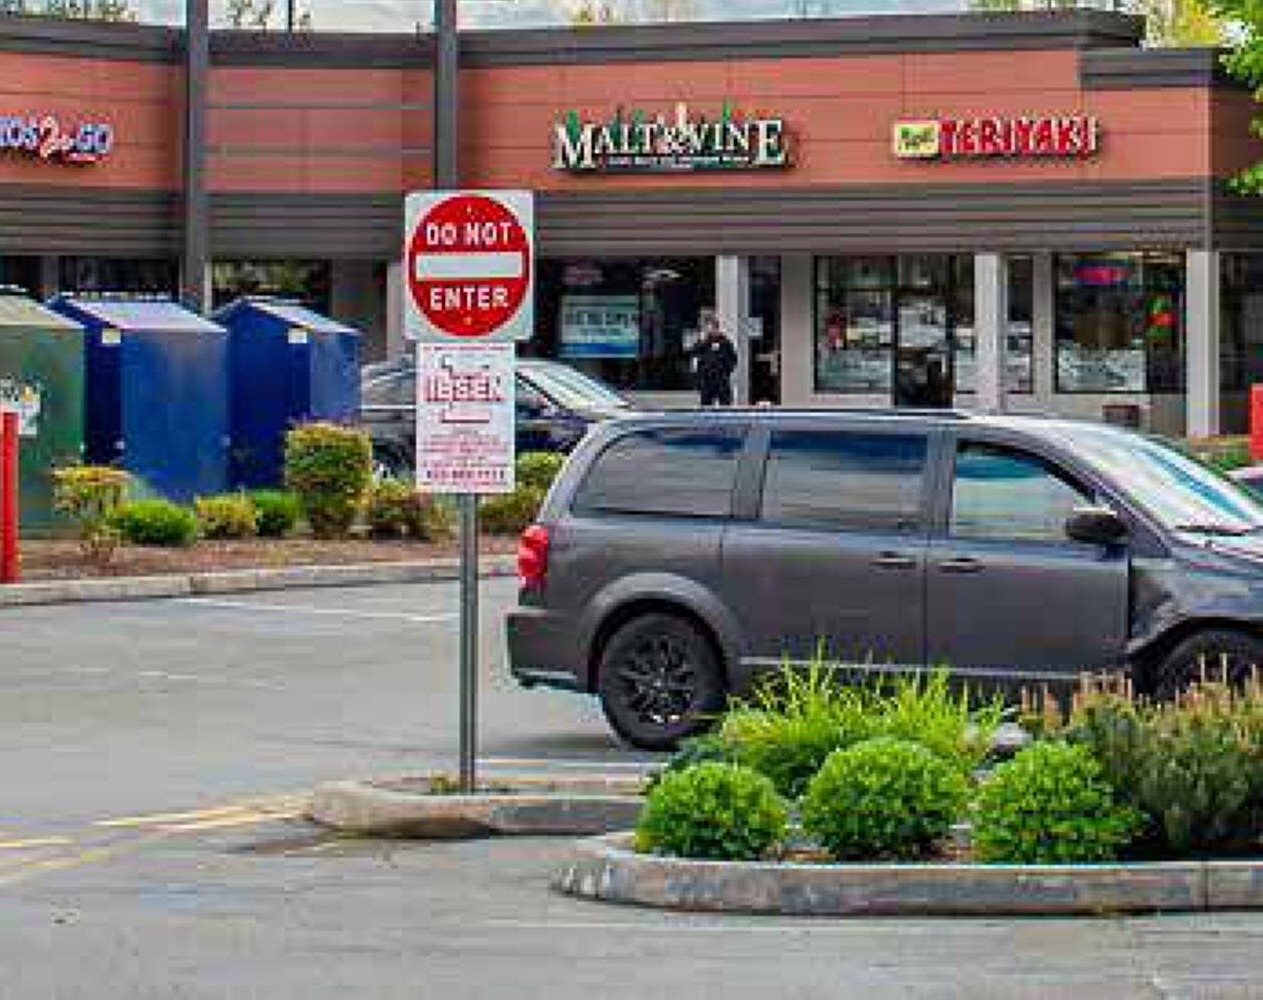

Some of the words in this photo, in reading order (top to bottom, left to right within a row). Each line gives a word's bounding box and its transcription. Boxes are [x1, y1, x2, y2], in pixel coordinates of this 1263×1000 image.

[940, 117, 1096, 155] TERIYAKI
[426, 222, 458, 246] DO
[464, 222, 512, 246] NOT
[429, 286, 509, 312] ENTER
